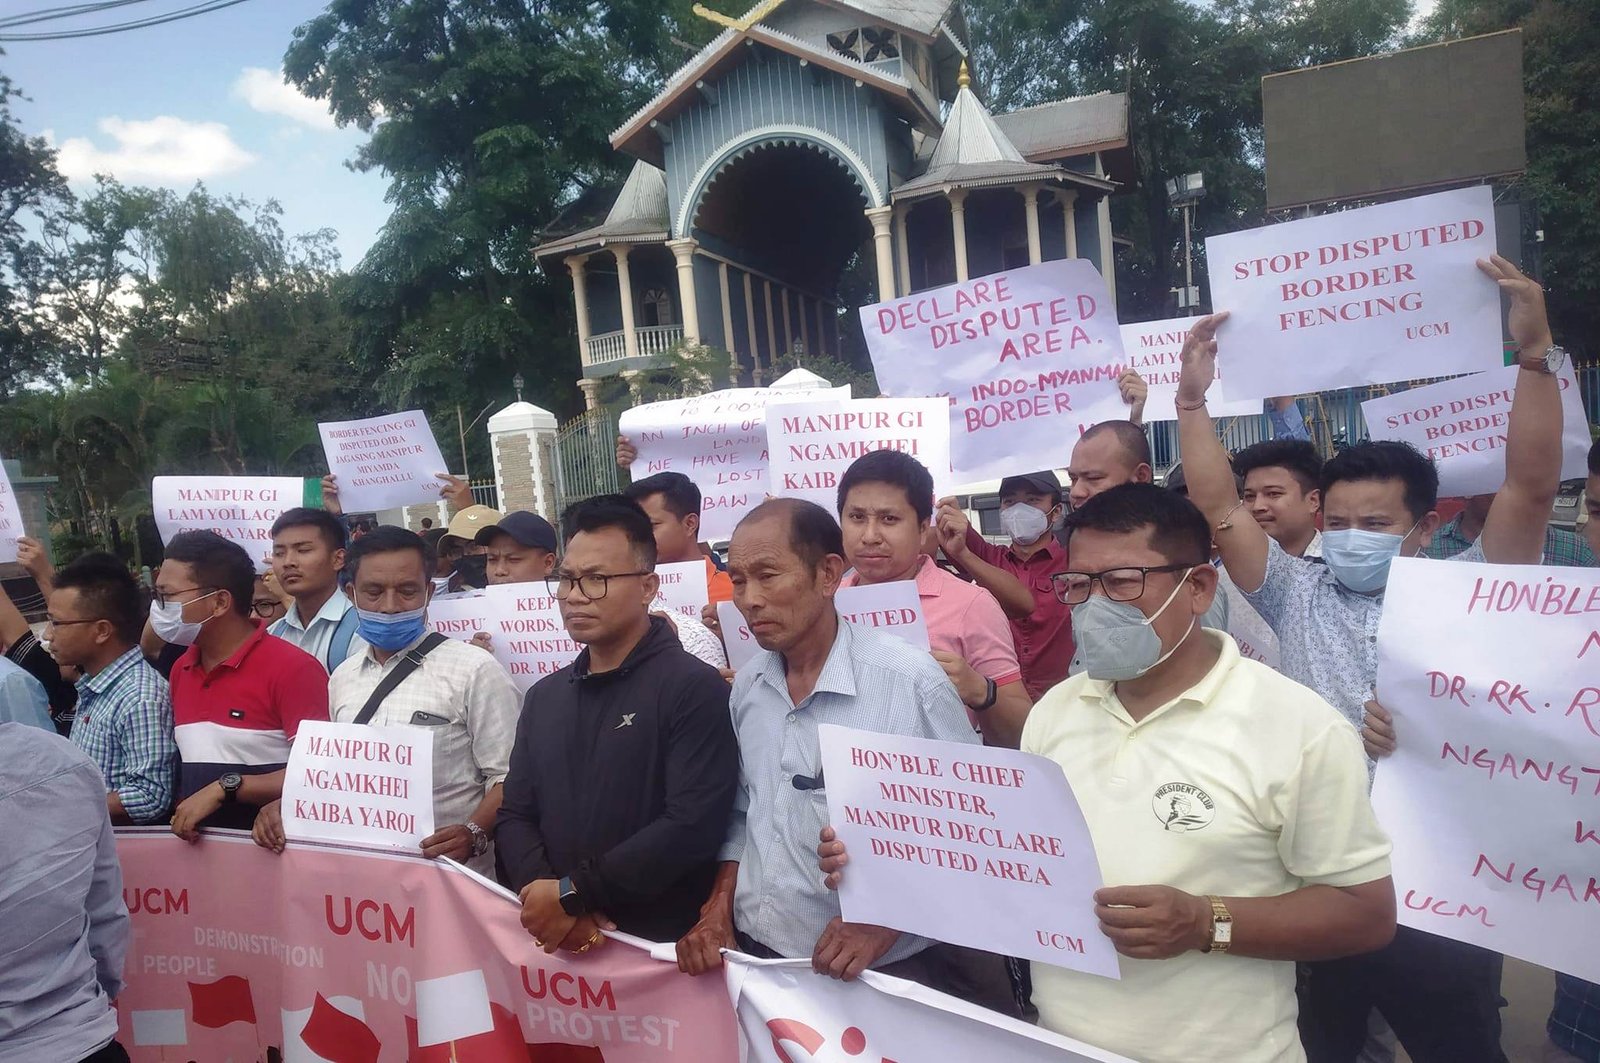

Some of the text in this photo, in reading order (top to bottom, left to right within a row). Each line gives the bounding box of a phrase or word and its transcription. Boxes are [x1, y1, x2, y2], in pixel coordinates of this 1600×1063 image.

[1234, 219, 1485, 280] STOP DISPUTED
[1281, 263, 1416, 302] BORDER
[877, 276, 1013, 334] DECLARE
[1279, 292, 1423, 332] FENCING
[930, 294, 1097, 349] DISPUTED
[1406, 321, 1450, 340] UCM
[999, 325, 1103, 362] AREA.
[972, 363, 1128, 401] INDO-MYANMA
[783, 411, 923, 434] MANIPUR GI
[965, 392, 1072, 433] BORDER
[1386, 405, 1444, 429] STOP
[1426, 411, 1512, 440] BORDE
[329, 420, 416, 439] BORDER FENCING GI
[339, 435, 406, 451] DISPUTED OIBA
[641, 418, 761, 442] AN INCH OF
[336, 444, 423, 464] JAGASING MANIPUR
[1427, 435, 1508, 461] FENCIN
[356, 462, 400, 475] MIYAMDA
[648, 458, 673, 473] WE
[693, 453, 740, 470] HAVE
[351, 472, 414, 487] KHANGHALLU
[421, 482, 440, 491] UCM
[717, 469, 764, 485] LOST
[784, 471, 845, 489] KAIB
[178, 489, 277, 501] MANIPUR GI
[516, 596, 555, 612] KEEP
[436, 618, 486, 633] DISPU
[500, 618, 559, 633] WORDS,
[510, 639, 583, 655] MINISTER
[510, 662, 534, 675] DR.
[1426, 671, 1476, 707] DR.
[306, 736, 413, 766] MANIPUR GI
[851, 747, 1025, 788] HON'BLE CHIEF
[304, 768, 408, 799] NGAMKHEI
[1155, 784, 1214, 810] PRESIDENT CLUB
[879, 782, 996, 820] MINISTER,
[294, 799, 416, 835] KAIBA YAROI
[844, 805, 1066, 857] MANIPUR DECLARE
[871, 838, 1053, 886] DISPUTED AREA
[122, 887, 189, 915] UCM
[1404, 889, 1495, 927] UCM
[324, 894, 416, 948] UCM
[1036, 930, 1086, 953] UCM
[144, 955, 217, 977] PEOPLE
[366, 960, 411, 1006] NO
[520, 965, 617, 1011] UCM
[527, 1001, 680, 1051] PROTEST
